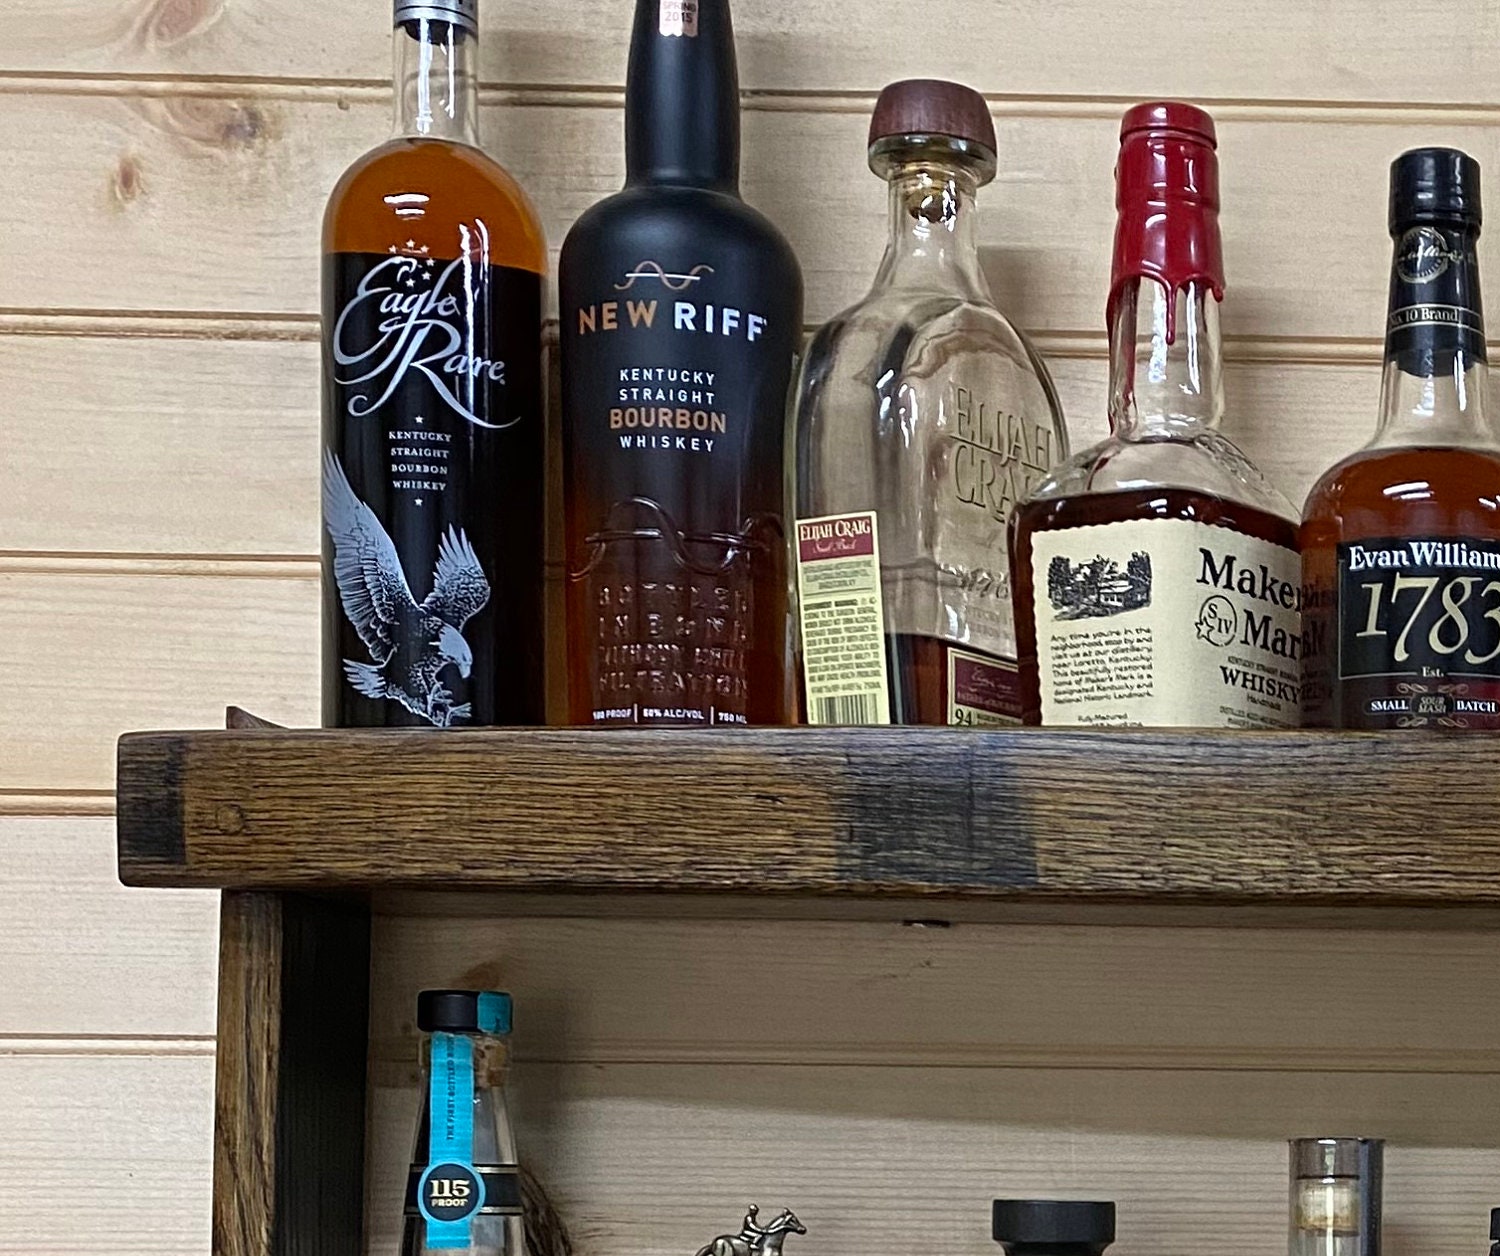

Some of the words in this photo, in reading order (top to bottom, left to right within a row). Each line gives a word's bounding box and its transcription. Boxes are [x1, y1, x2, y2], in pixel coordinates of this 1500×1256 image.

[578, 300, 657, 335] NEW
[674, 301, 765, 342] RIFF
[1421, 307, 1458, 322] Brand
[619, 368, 715, 386] KENTUCKY
[619, 388, 715, 405] STRAIGHT
[610, 407, 726, 433] BOURBON
[388, 431, 452, 442] KENTUCKY
[619, 436, 714, 452] WHISKEY
[391, 447, 450, 459] STRAIGHT
[391, 463, 448, 474] BOURBON
[392, 480, 447, 491] WHISKEY
[799, 524, 833, 541] ELIJAH
[835, 519, 871, 538] CRAIG
[1348, 545, 1409, 571] Evan
[1421, 666, 1445, 678] Est.
[606, 709, 632, 718] PROOF
[663, 708, 704, 719] ALC/VOL
[1370, 699, 1409, 712] SMALL
[1456, 699, 1496, 713] BATCH
[955, 708, 972, 726] 94
[430, 1179, 471, 1197] 115
[431, 1198, 469, 1207] PROOF
